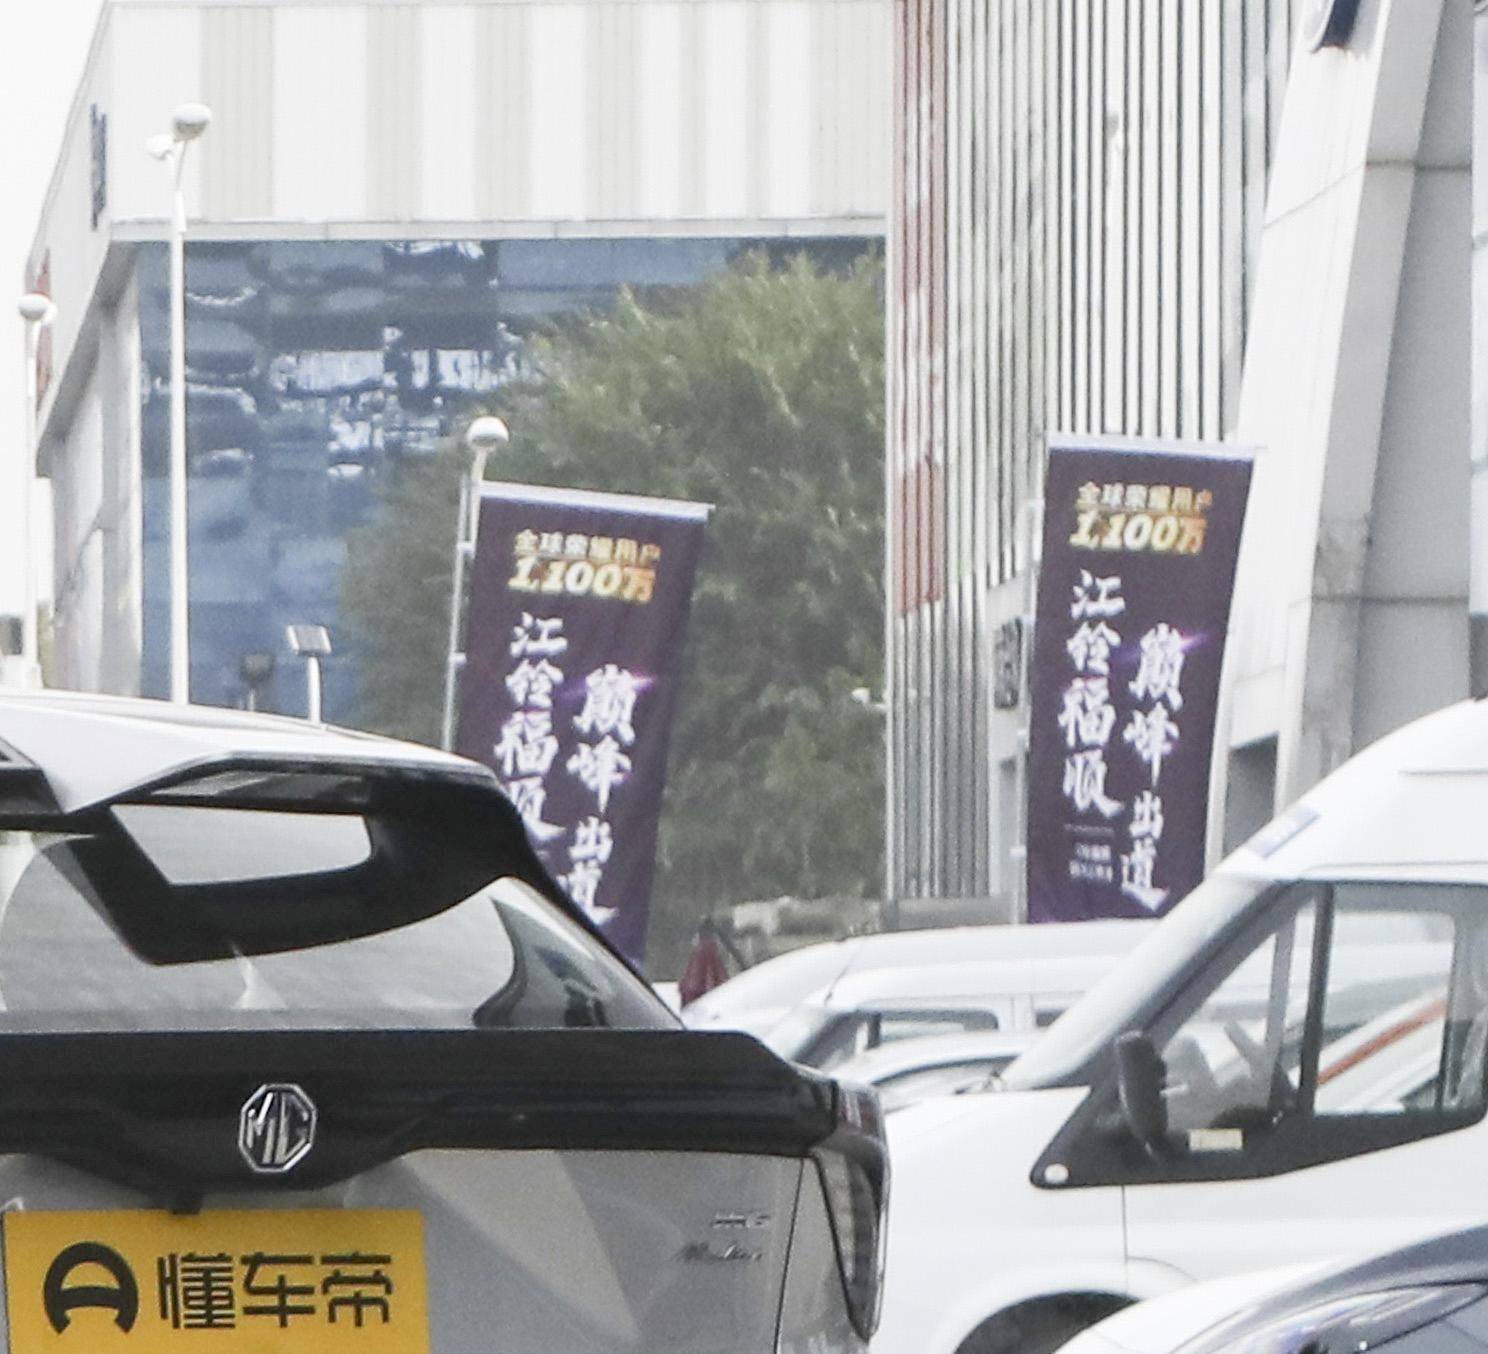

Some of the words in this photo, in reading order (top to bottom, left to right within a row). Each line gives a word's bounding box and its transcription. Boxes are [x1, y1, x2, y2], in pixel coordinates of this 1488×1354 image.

[1058, 568, 1125, 819] 江铃福顺
[1120, 622, 1187, 912] 巅峰出道
[245, 1090, 309, 1165] MG
[157, 1251, 393, 1330] 懂车帝
